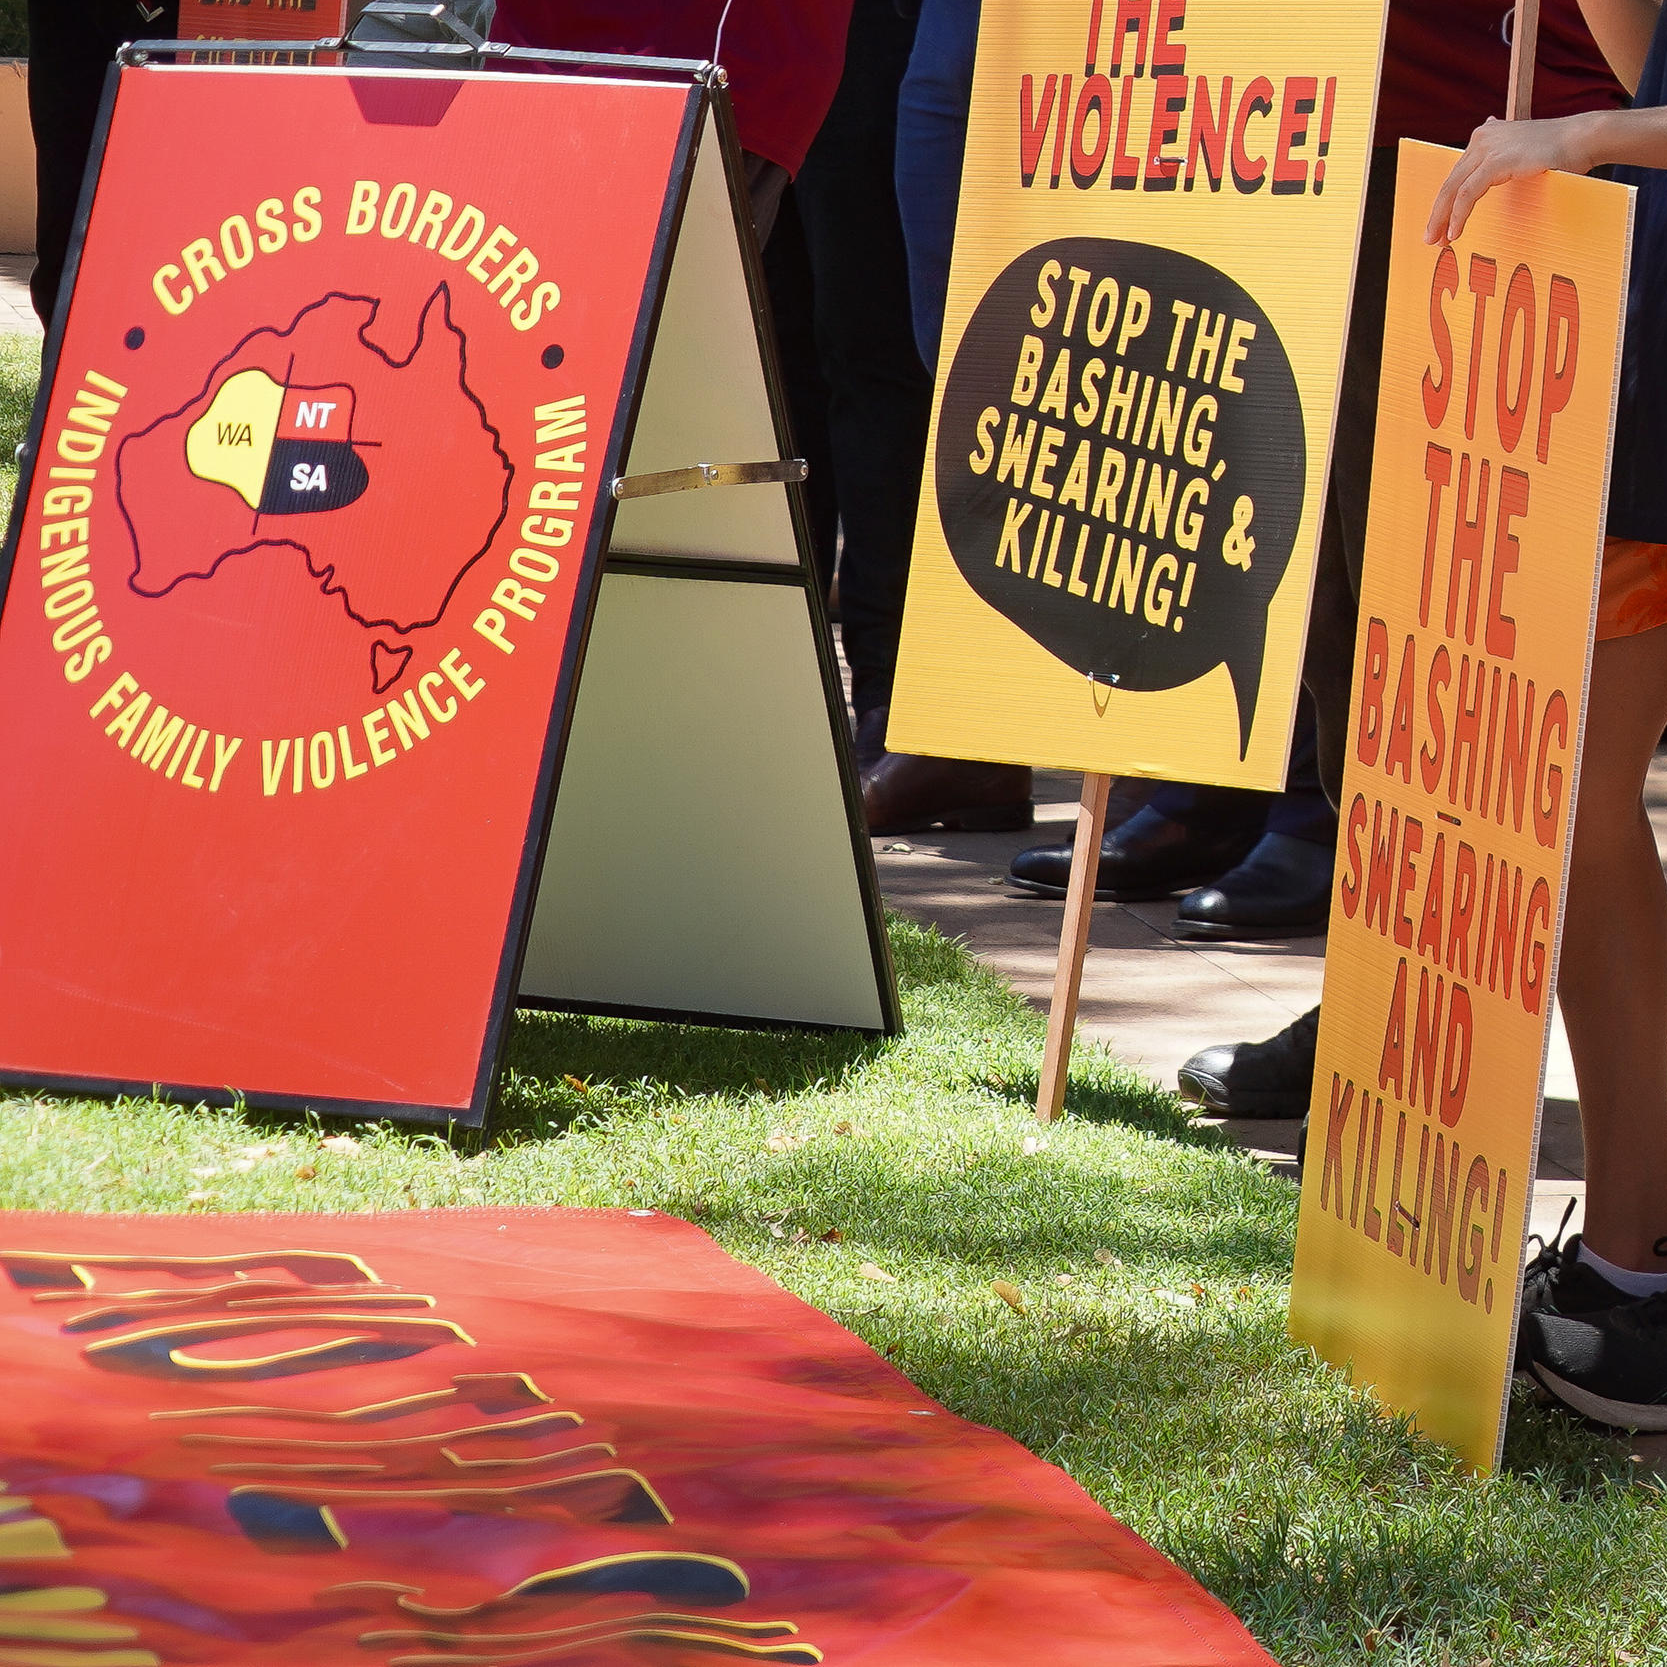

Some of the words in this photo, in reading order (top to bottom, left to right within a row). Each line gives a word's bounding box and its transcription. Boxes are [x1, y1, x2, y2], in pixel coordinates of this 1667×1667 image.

[1019, 73, 1337, 196] VIOLENCE!
[152, 185, 323, 318] CROSS
[346, 180, 562, 333] BORDERS
[1030, 259, 1149, 359] STOP
[1169, 296, 1256, 394] THE
[217, 420, 253, 448] WA
[295, 400, 335, 432] NT
[1011, 334, 1231, 481] BASHING,
[1421, 247, 1579, 464] STOP
[289, 462, 328, 494] SA
[968, 408, 1207, 550] SWEARING
[1223, 498, 1256, 573] &
[1419, 443, 1530, 659] THE
[38, 369, 129, 686] INDIGENOUS
[88, 670, 241, 794] FAMILY
[261, 640, 486, 797] VIOLENCE
[474, 393, 589, 653] PROGRAM
[995, 503, 1197, 632] KILLING!
[1356, 617, 1570, 851] BASHING
[1342, 805, 1553, 1016] SWEARING
[1378, 957, 1474, 1130] AND
[1319, 1070, 1506, 1314] KILLING!
